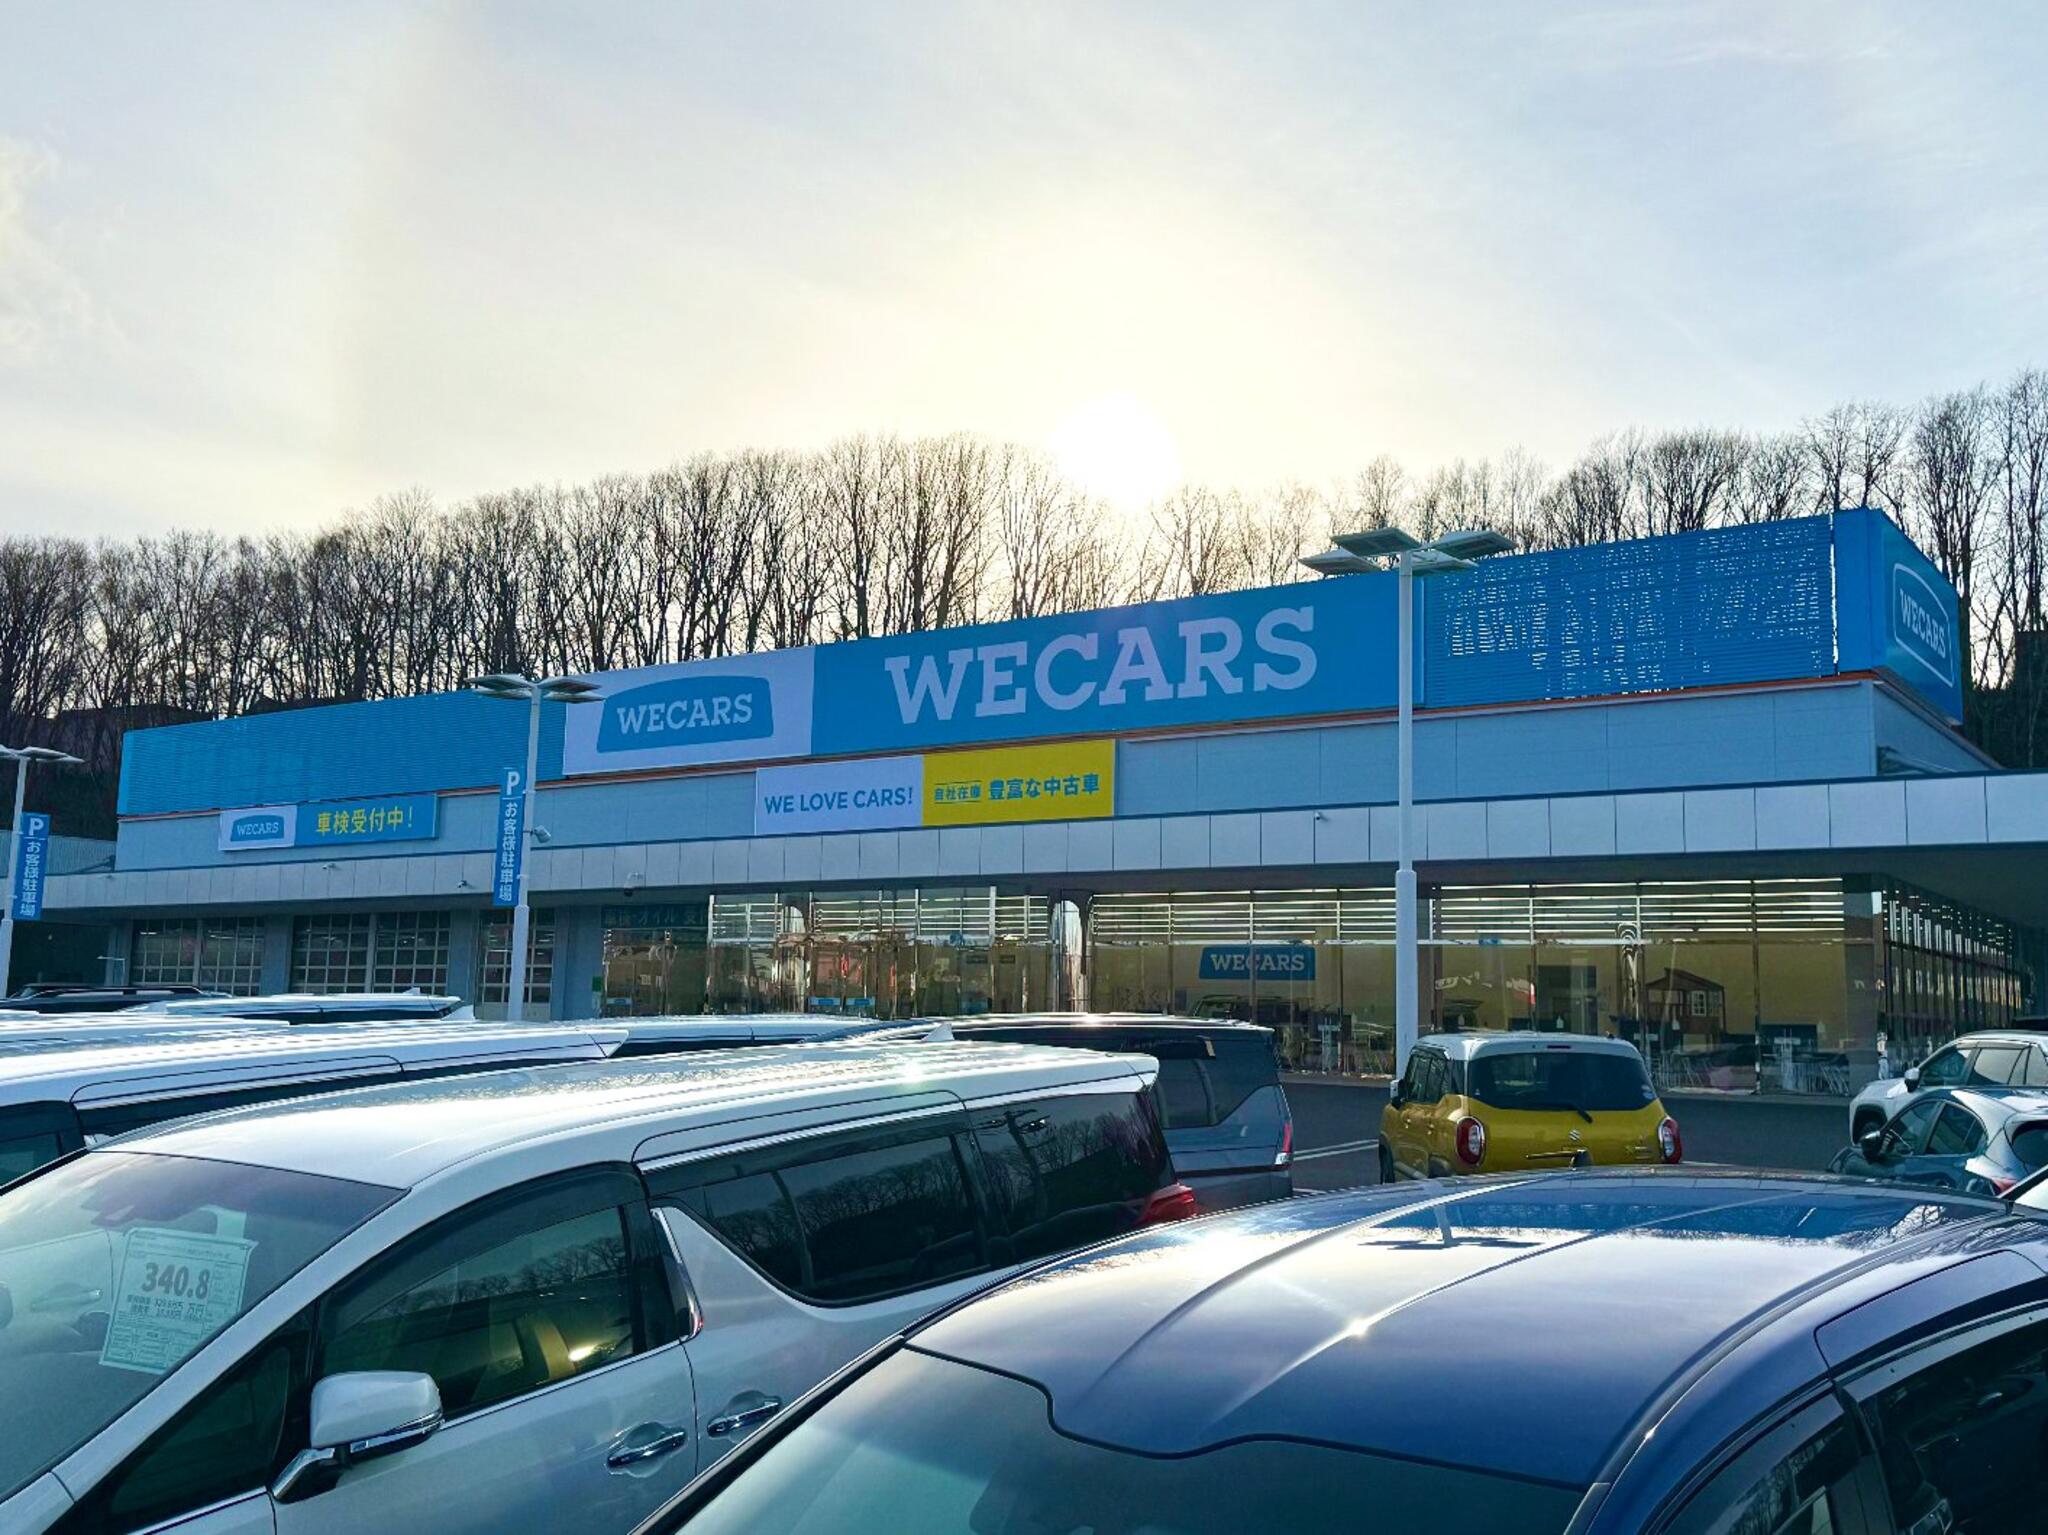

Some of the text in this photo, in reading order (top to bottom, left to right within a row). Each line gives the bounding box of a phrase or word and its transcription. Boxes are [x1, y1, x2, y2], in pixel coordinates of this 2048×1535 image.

[1899, 588, 1946, 659] WECARS
[884, 606, 1318, 724] WECARS
[617, 693, 753, 735] WECARS
[506, 771, 521, 796] P
[764, 787, 914, 814] WE LOVE CARS!
[988, 773, 1100, 801] 豊富な中古車
[28, 817, 44, 836] P
[237, 821, 279, 836] WECARS
[499, 802, 518, 902] お客様駐車場
[20, 841, 41, 917] お客様駐車場
[141, 1262, 210, 1299] 340.8
